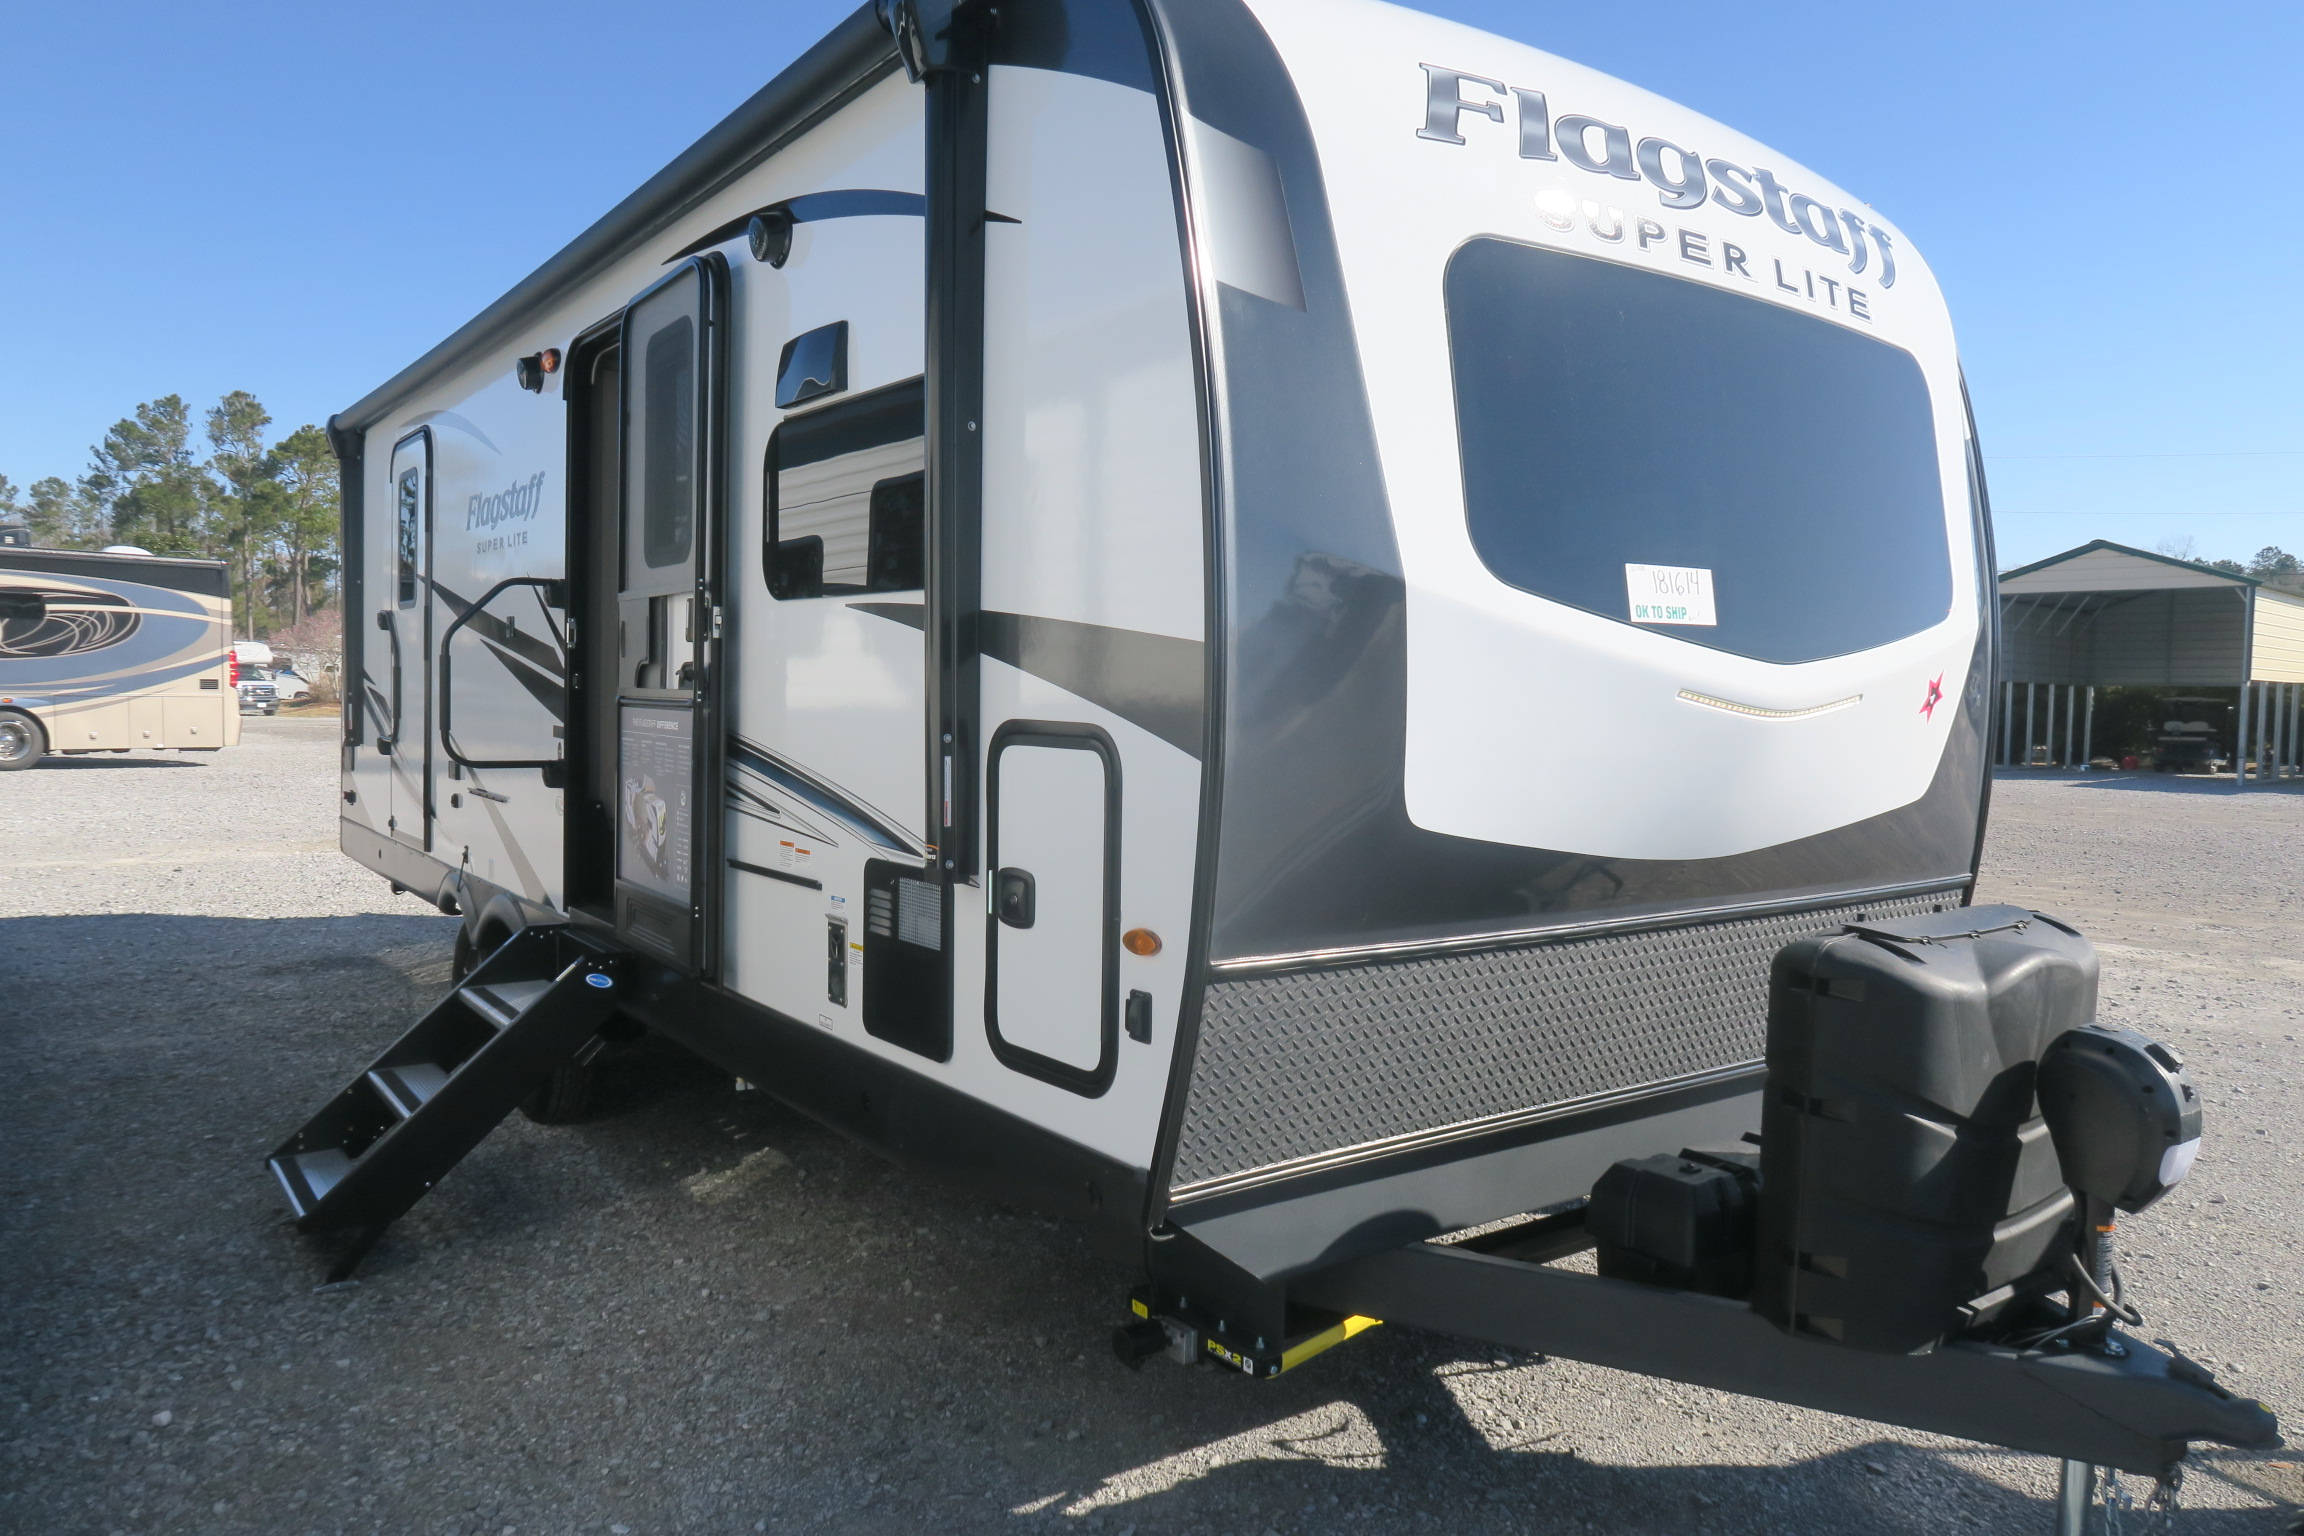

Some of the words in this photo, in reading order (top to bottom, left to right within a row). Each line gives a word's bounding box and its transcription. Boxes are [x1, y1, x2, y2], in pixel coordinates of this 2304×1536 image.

[1415, 61, 1897, 290] Flagstaff
[1771, 255, 1873, 324] LITE
[465, 470, 546, 532] Flagstaff
[476, 537, 504, 555] SUPER
[507, 531, 528, 547] LITE
[1652, 569, 1700, 596] 181614
[1635, 604, 1649, 619] OK
[1651, 605, 1663, 619] TO
[1665, 605, 1687, 620] SHIP
